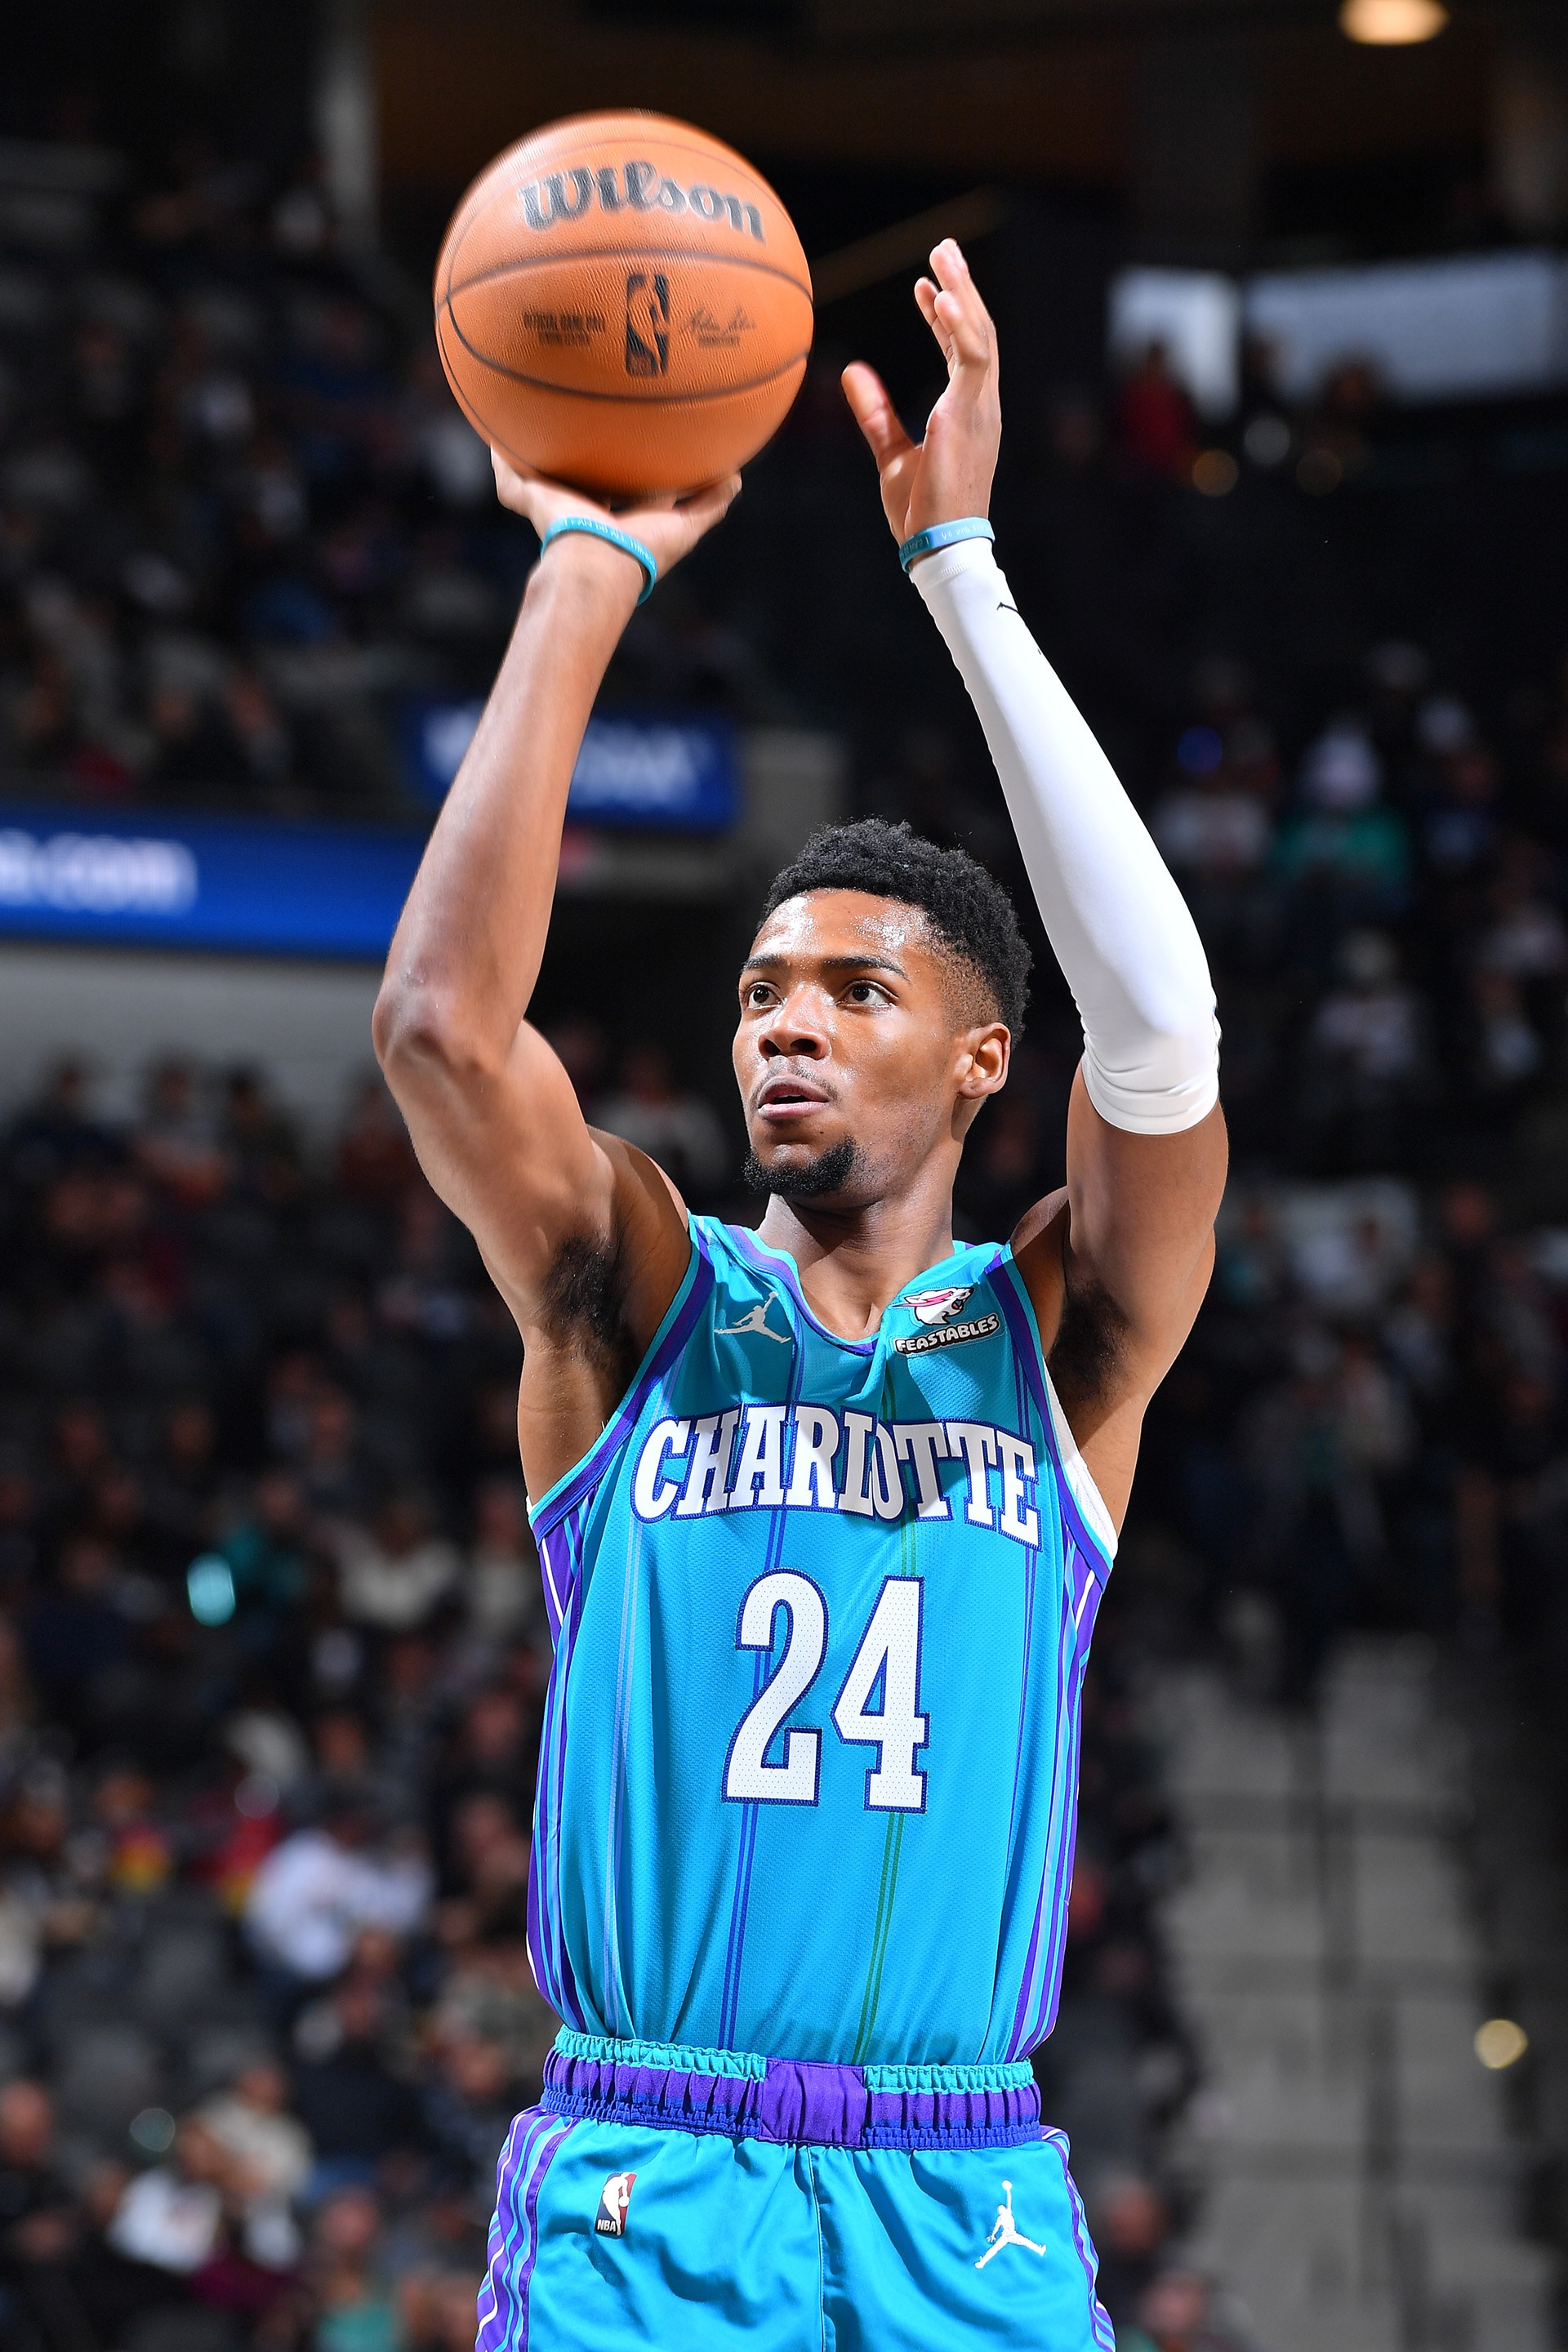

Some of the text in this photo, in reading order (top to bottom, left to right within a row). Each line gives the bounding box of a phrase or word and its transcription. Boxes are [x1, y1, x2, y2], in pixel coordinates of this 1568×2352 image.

[518, 161, 765, 243] Wilson
[895, 1314, 999, 1352] FEASTABLES
[630, 1401, 1044, 1552] CHARLOTTE
[722, 1567, 930, 1814] 24
[597, 2219, 617, 2232] NBA
